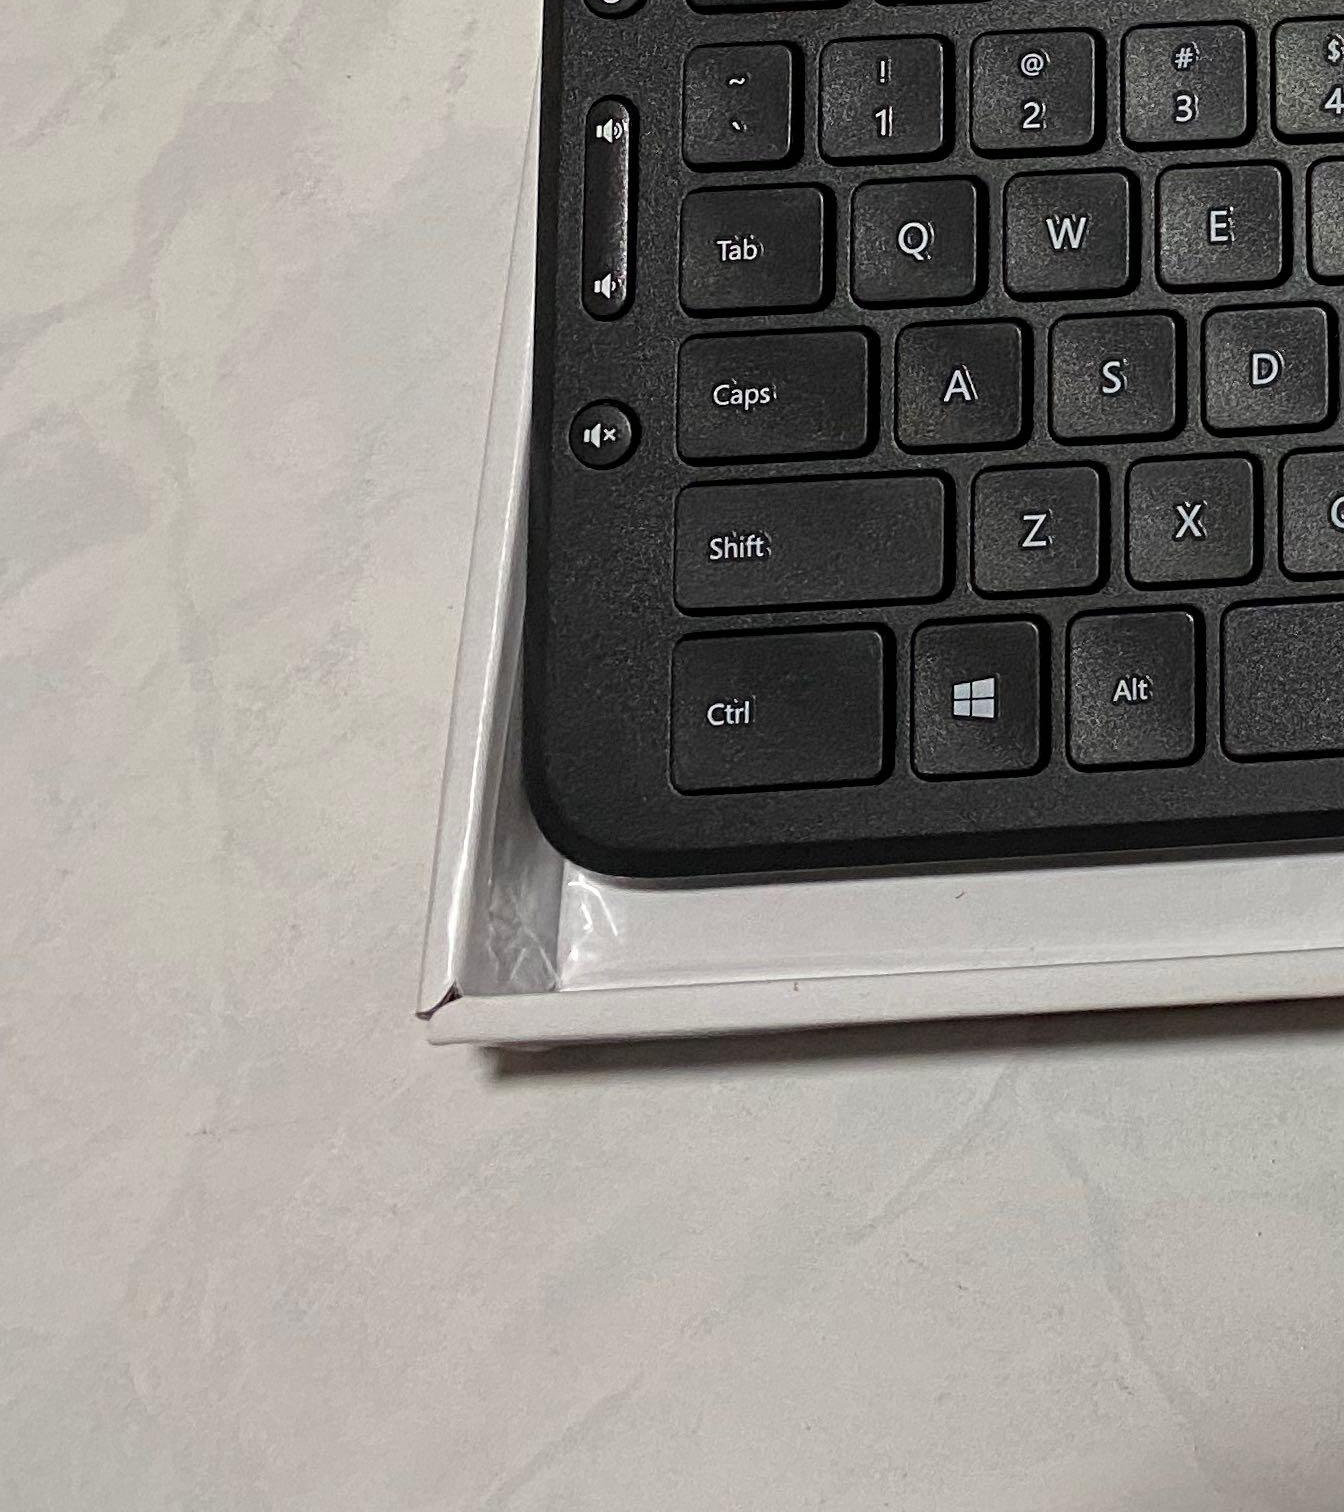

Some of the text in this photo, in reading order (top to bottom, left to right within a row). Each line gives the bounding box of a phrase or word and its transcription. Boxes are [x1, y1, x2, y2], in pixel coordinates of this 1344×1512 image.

[1020, 52, 1045, 76] @
[1022, 103, 1044, 129] 2
[1175, 96, 1196, 122] 3
[875, 110, 890, 136] 1
[1046, 215, 1087, 249] W
[1210, 208, 1229, 242] E
[718, 238, 759, 261] Tab
[898, 222, 930, 259] Q
[1101, 361, 1123, 394] S
[1251, 353, 1280, 385] D
[713, 382, 770, 409] Caps
[943, 368, 973, 402] A
[1022, 514, 1048, 547] Z
[1175, 503, 1204, 538] X
[709, 534, 765, 561] Shift
[1113, 679, 1148, 703] Alt
[707, 702, 750, 726] Ctrl
